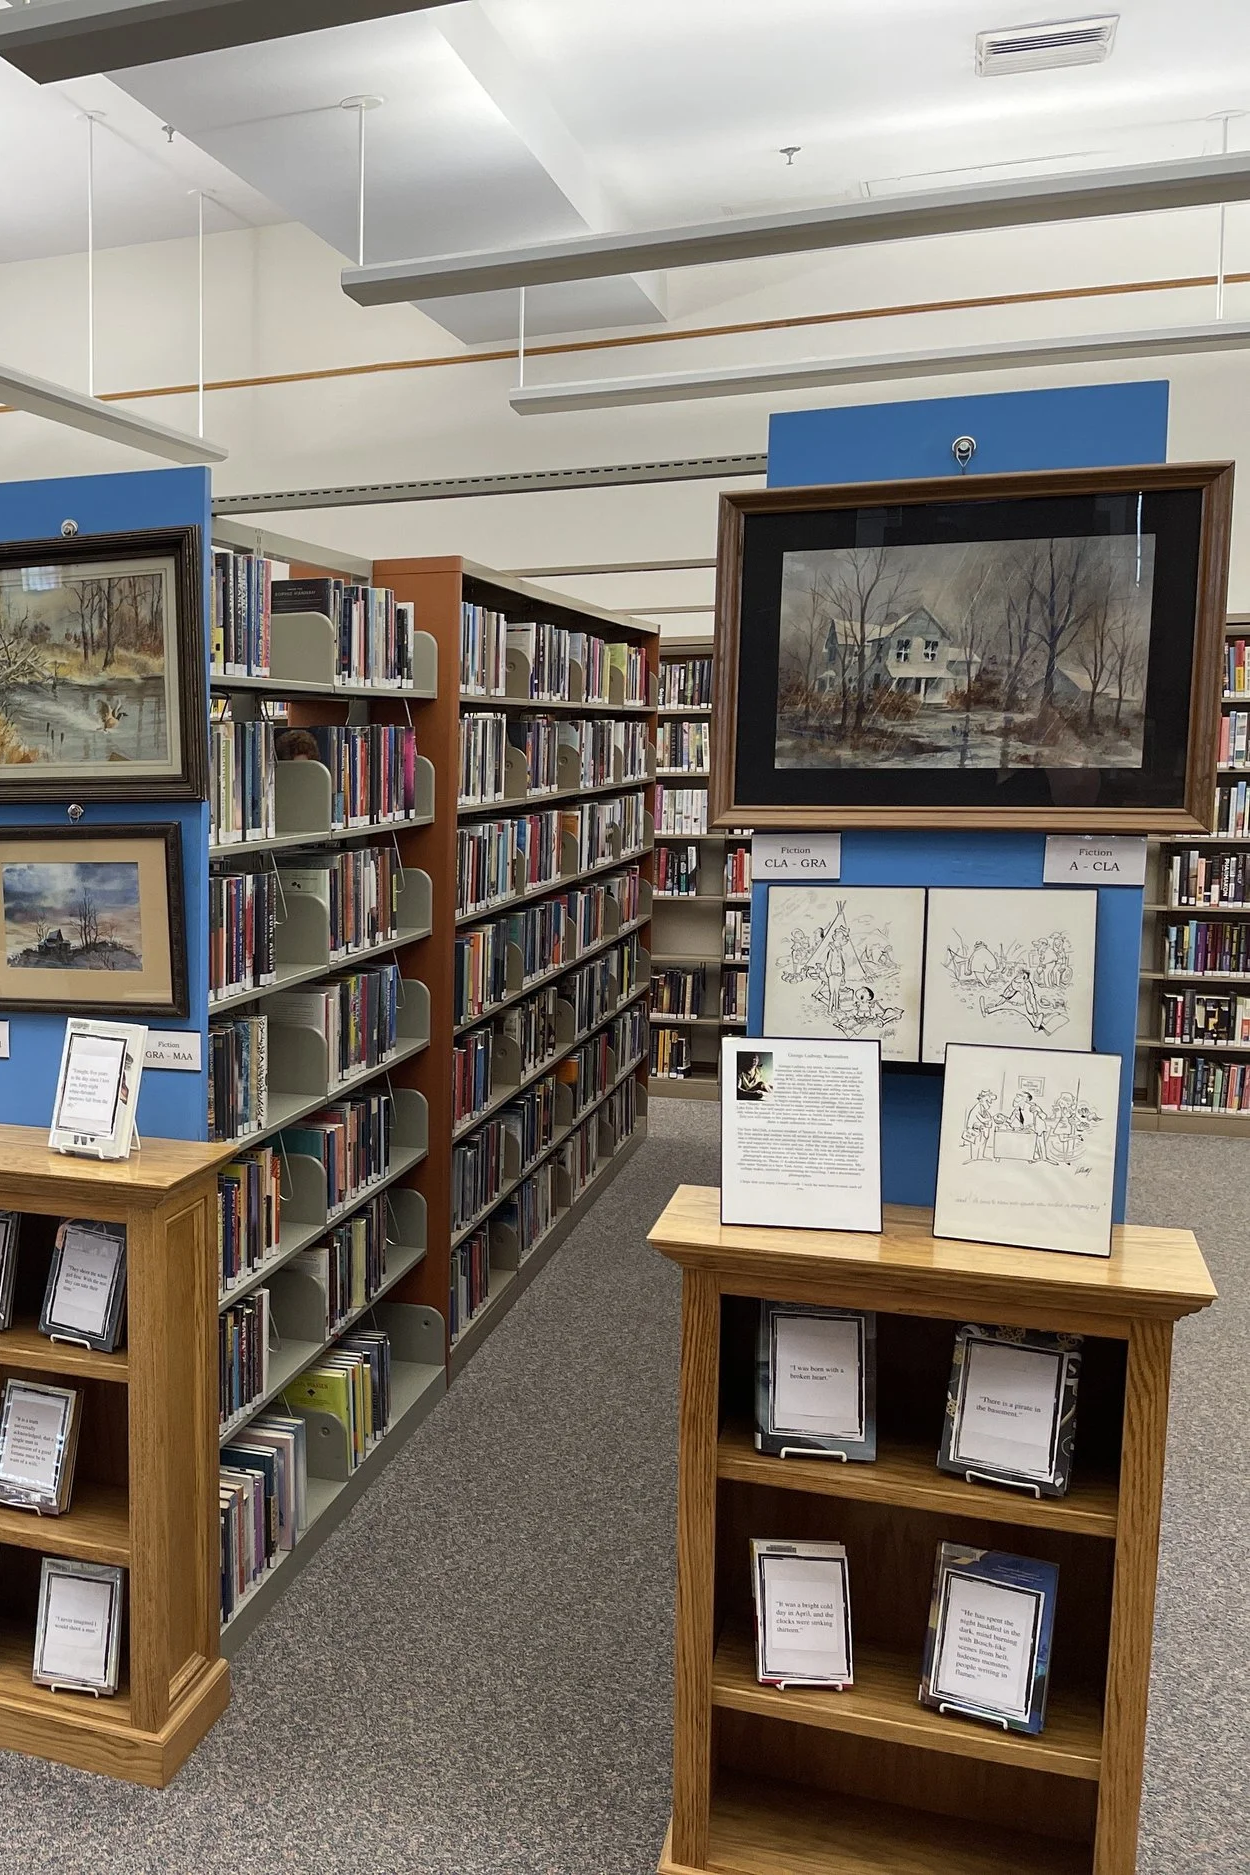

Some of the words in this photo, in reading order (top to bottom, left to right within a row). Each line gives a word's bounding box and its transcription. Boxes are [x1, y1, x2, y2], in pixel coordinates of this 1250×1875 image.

[781, 846, 811, 855] Fiction
[1079, 848, 1113, 857] Fiction
[764, 858, 788, 868] CLA
[800, 858, 827, 868] GRA
[1069, 861, 1079, 871] A
[1093, 861, 1120, 872] CLA
[145, 1051, 164, 1059] GRA
[173, 1052, 193, 1061] MAA
[802, 1602, 819, 1610] bright
[975, 1612, 985, 1620] has
[987, 1616, 1003, 1624] spent
[1004, 1619, 1014, 1627] the
[977, 1622, 1002, 1632] huddled
[959, 1627, 974, 1635] dark,
[976, 1631, 992, 1639] mind
[994, 1635, 1018, 1646] burning
[974, 1639, 1006, 1651] Bosch-like
[958, 1645, 977, 1653] scenes
[979, 1649, 994, 1657] from
[995, 1652, 1008, 1661] hell,
[955, 1661, 977, 1670] people
[982, 1659, 1011, 1671] monsters,
